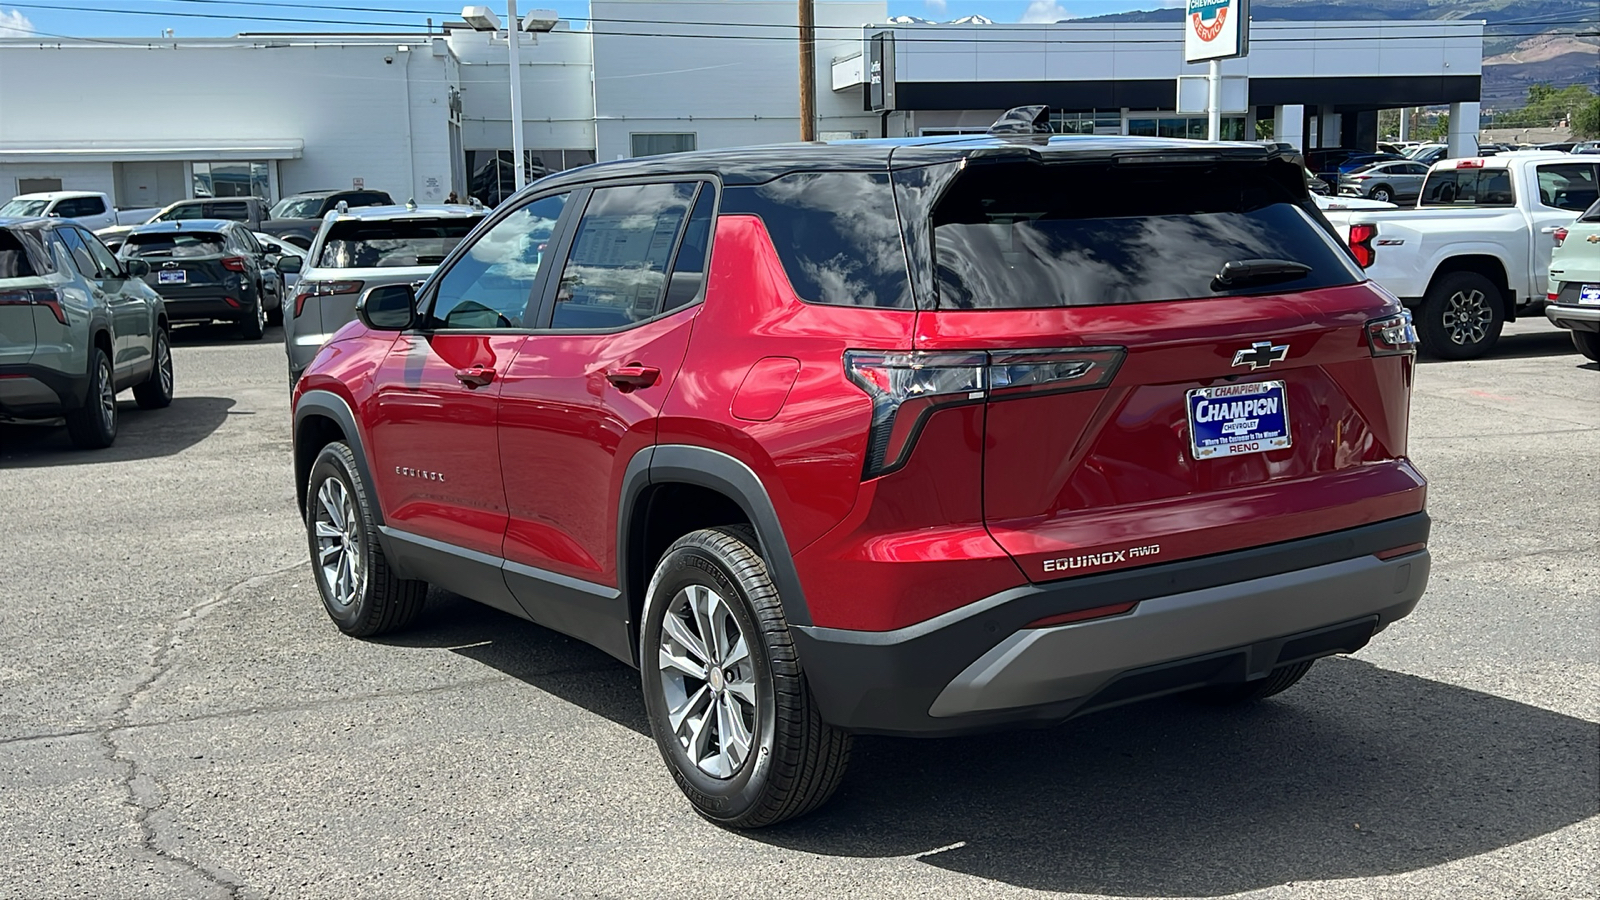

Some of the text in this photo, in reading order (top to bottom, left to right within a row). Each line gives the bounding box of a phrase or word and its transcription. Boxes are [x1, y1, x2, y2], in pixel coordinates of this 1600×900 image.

[1194, 13, 1225, 38] SERVICE
[1215, 384, 1260, 397] CHAMPION
[1196, 397, 1278, 423] CHAMPION
[1224, 421, 1257, 431] CHEVROLET
[1229, 442, 1259, 453] RENO
[395, 466, 445, 482] EQUINOX
[1043, 544, 1160, 572] EQUINOX AWD
[686, 555, 727, 589] MICHELIN
